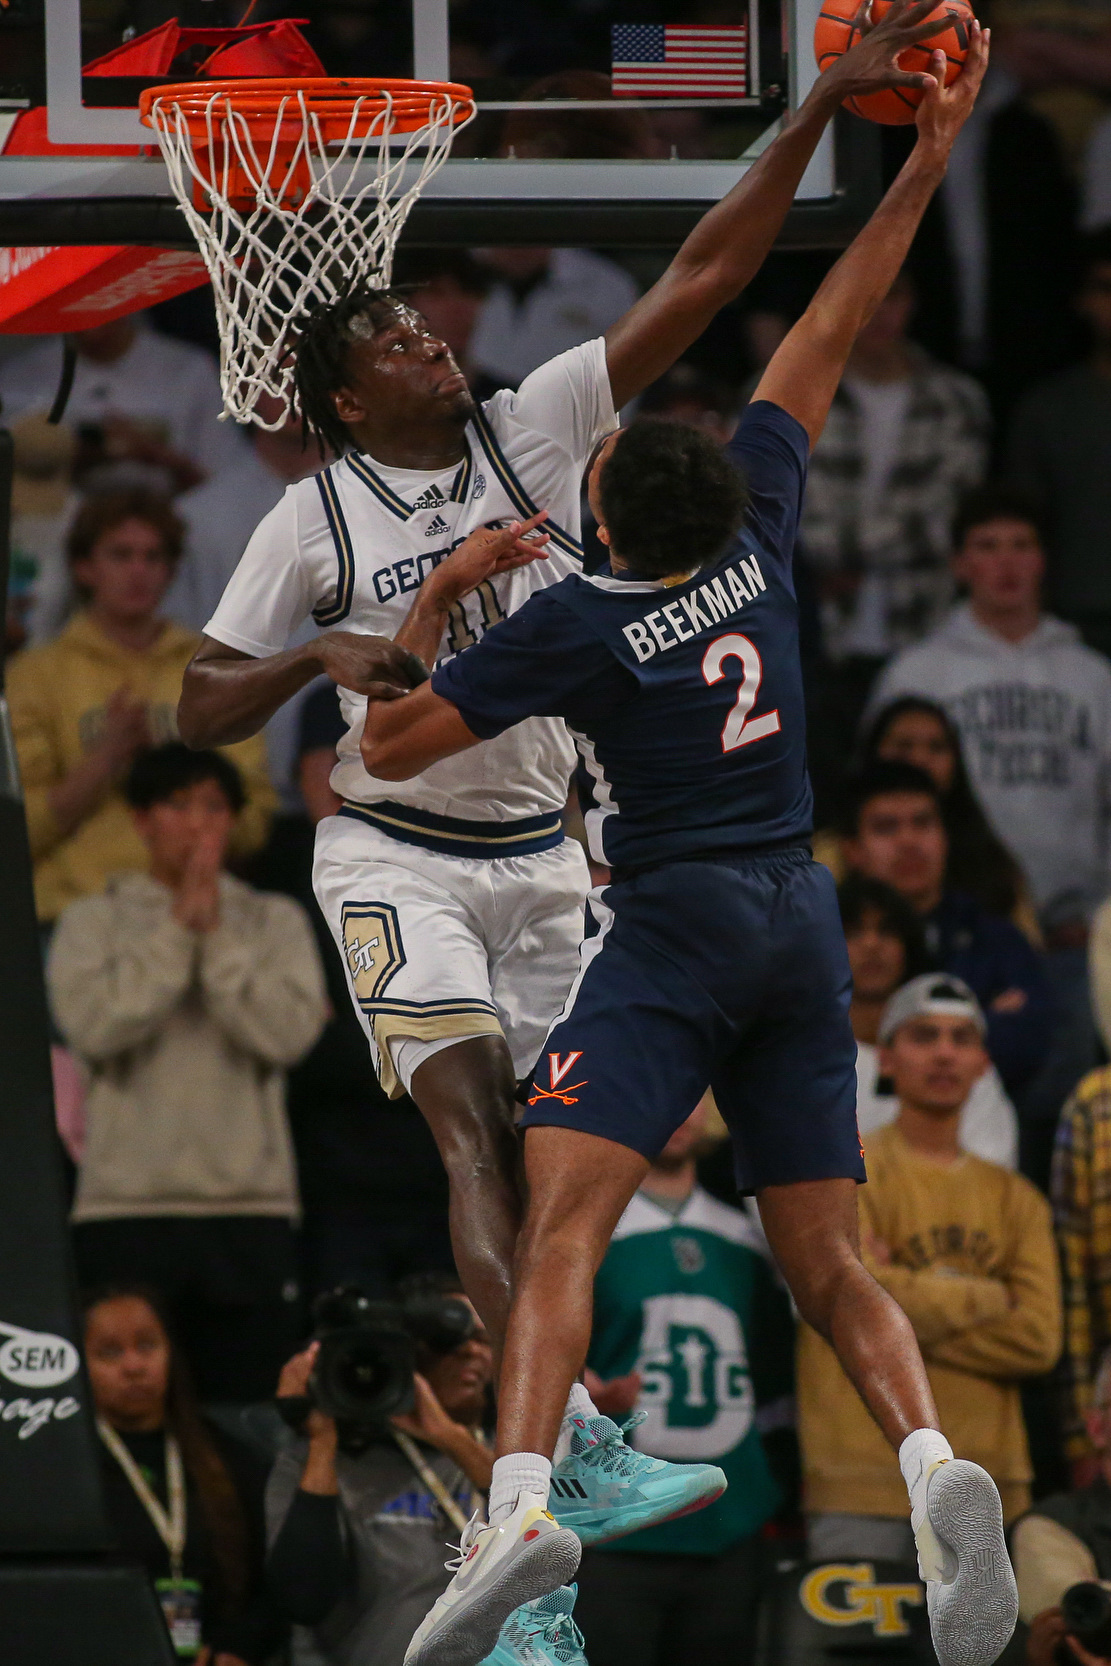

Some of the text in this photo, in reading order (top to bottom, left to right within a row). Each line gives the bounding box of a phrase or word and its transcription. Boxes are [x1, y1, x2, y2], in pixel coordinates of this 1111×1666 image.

[447, 580, 508, 656] 11
[621, 554, 768, 664] BEEKMAN
[701, 632, 782, 754] 2
[548, 1051, 584, 1090] V
[8, 1347, 67, 1372] SEM
[0, 1396, 81, 1441] age
[799, 1562, 924, 1637] GT
